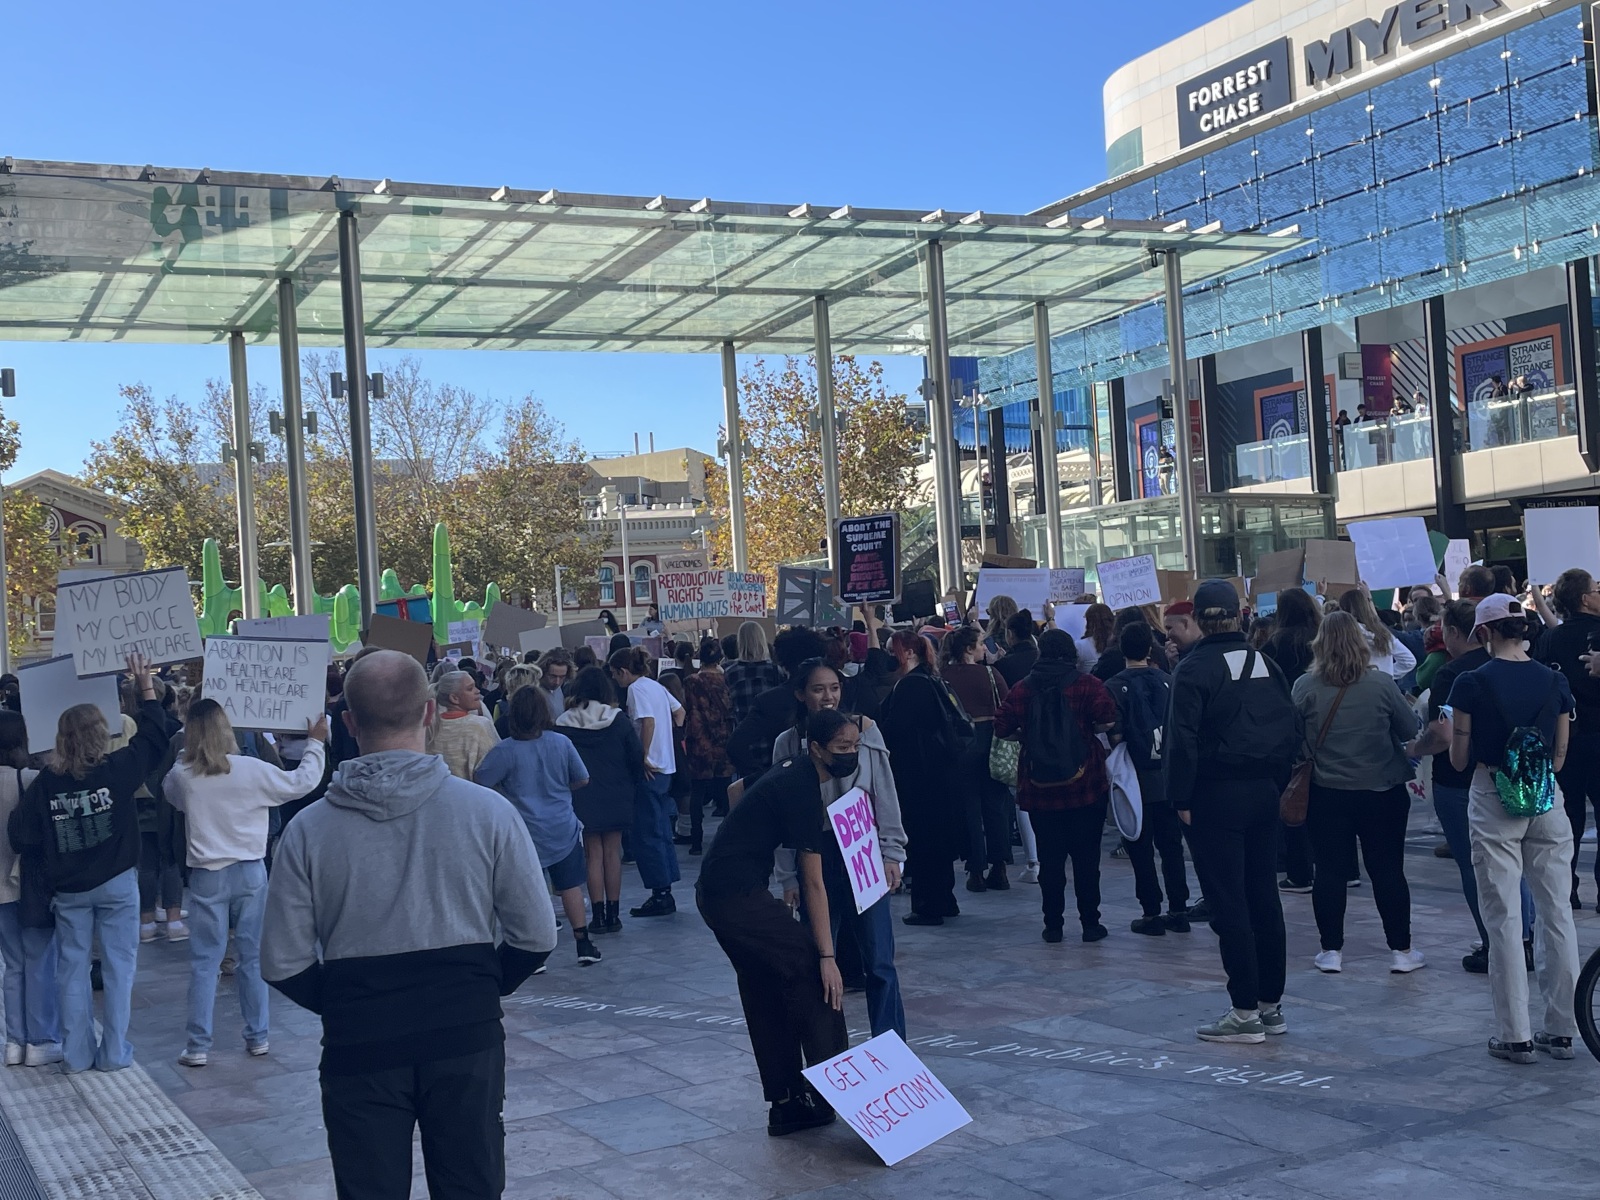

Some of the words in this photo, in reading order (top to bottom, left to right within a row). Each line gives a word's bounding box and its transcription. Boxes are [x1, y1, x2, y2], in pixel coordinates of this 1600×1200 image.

[1188, 59, 1272, 112] FORREST
[1200, 92, 1262, 132] CHASE
[1511, 340, 1552, 357] STRANGE
[1466, 350, 1505, 367] STRANGE
[1512, 354, 1532, 366] 2022
[1512, 360, 1553, 376] STRANGE
[1263, 394, 1293, 408] STRANGE
[1526, 500, 1555, 508] sushi
[1558, 499, 1586, 507] sushi
[841, 522, 871, 533] ABORT
[874, 520, 891, 529] THE
[846, 530, 887, 542] SUPREME
[1099, 560, 1130, 574] WOMENS
[1132, 556, 1151, 566] LIVES
[658, 571, 725, 589] REPRODUCTIVE
[69, 583, 103, 612] MY
[113, 574, 169, 608] BODY
[667, 587, 704, 604] RIGHTS
[1050, 591, 1080, 600] INIMUM
[1109, 587, 1152, 607] OPINION!
[660, 602, 694, 620] HUMAN
[696, 600, 728, 618] RIGHTS
[729, 600, 743, 616] the
[76, 618, 102, 642] MY
[108, 605, 183, 640] CHOICE
[82, 646, 107, 670] MY
[207, 640, 283, 664] ABORTION
[294, 645, 309, 667] IS
[225, 661, 297, 682] HEALTHCARE
[203, 677, 228, 691] AND
[235, 678, 309, 699] HEALTHCARE
[223, 696, 238, 718] A
[243, 695, 294, 721] RIGHT
[851, 838, 880, 893] MY
[614, 1005, 701, 1019] that
[824, 1055, 868, 1091] GET
[863, 1049, 890, 1075] A
[906, 1034, 979, 1050] the
[966, 1039, 1174, 1072] public's
[1185, 1063, 1331, 1090] right.
[847, 1069, 945, 1140] VASECTOMY
